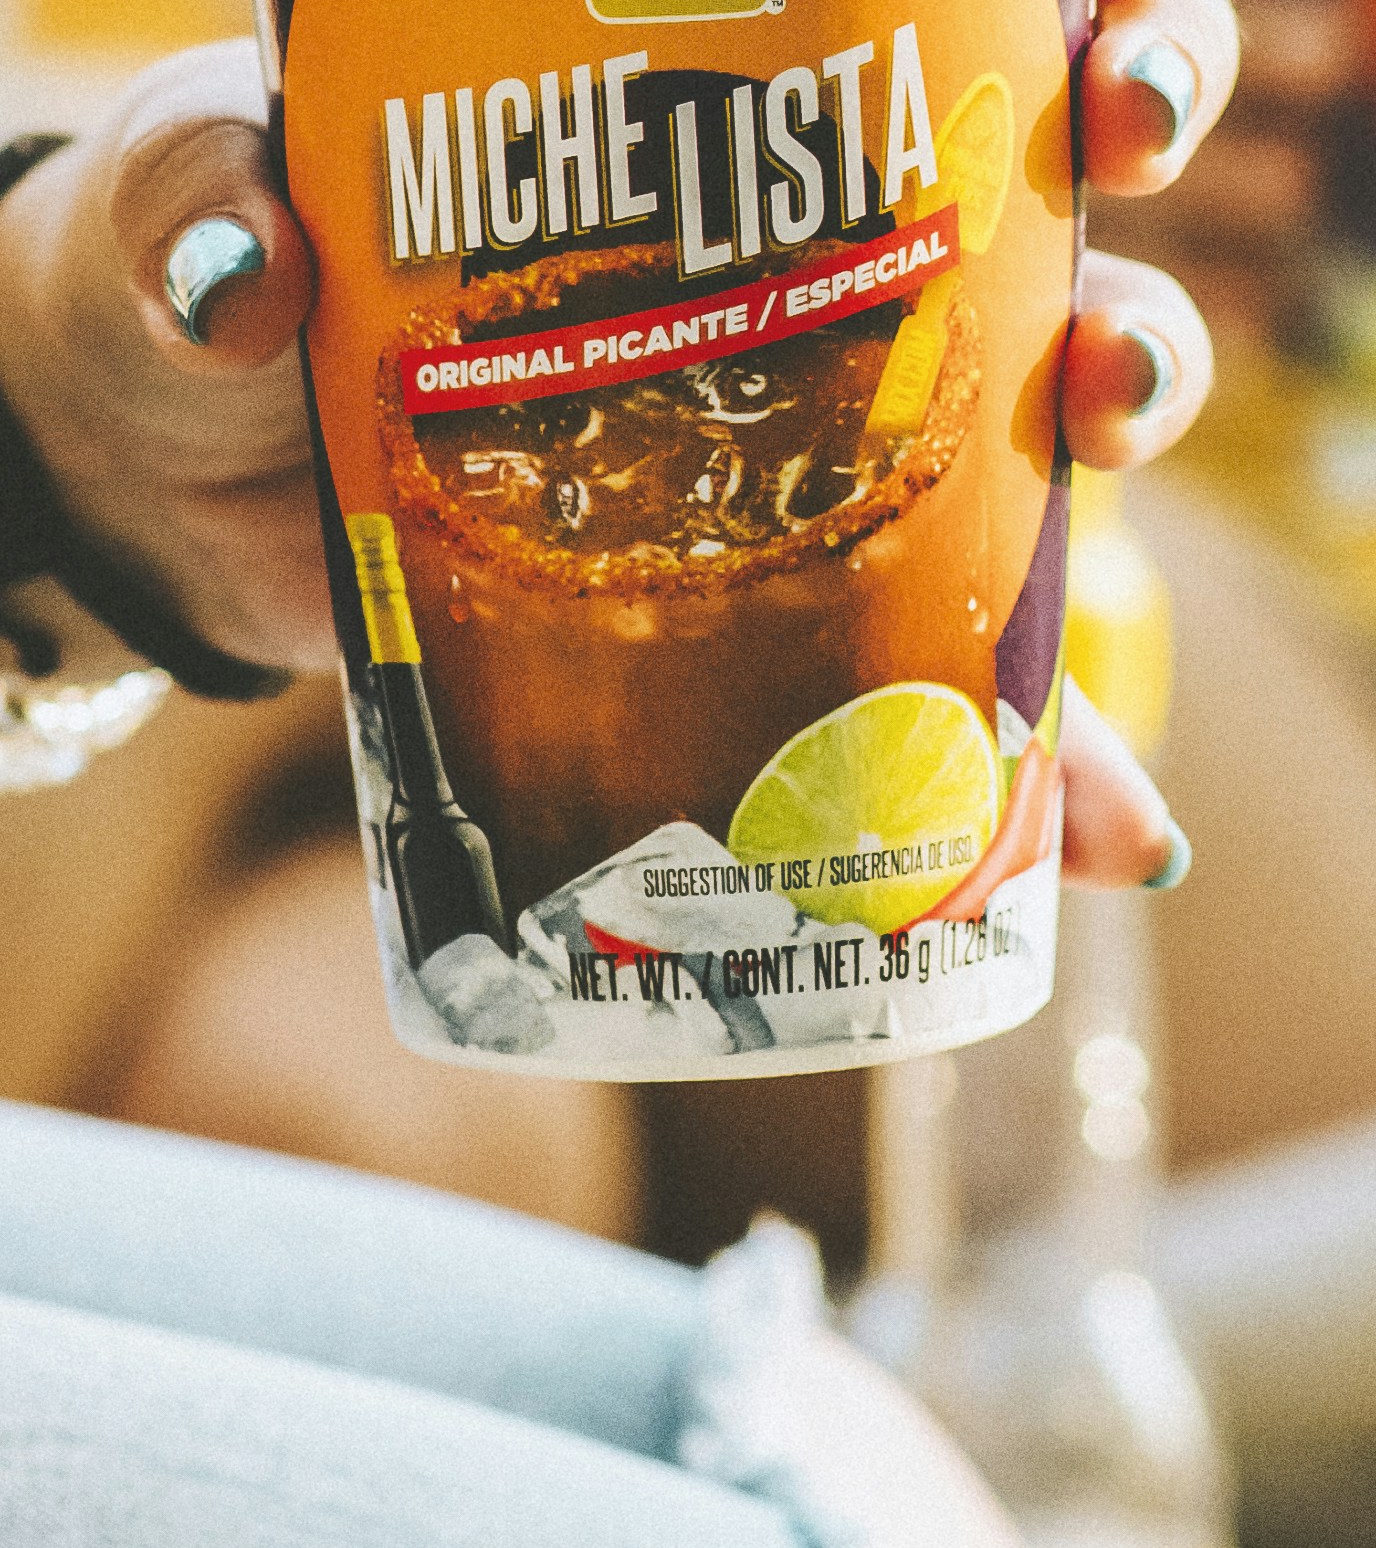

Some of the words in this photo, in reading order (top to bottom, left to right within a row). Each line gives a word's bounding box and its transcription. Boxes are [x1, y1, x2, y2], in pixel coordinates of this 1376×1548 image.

[415, 344, 575, 393] ORIGINAL
[583, 303, 750, 369] PICANTE
[755, 291, 778, 332] /
[785, 231, 949, 318] ESPECIAL
[643, 863, 750, 898] SUGGESTION
[755, 861, 775, 892] OF
[780, 859, 812, 890] USE
[829, 847, 924, 886] SUGERENCIA
[928, 842, 944, 870] DE
[569, 952, 629, 1002] NET.
[634, 951, 692, 1002] WT.
[723, 944, 805, 998] CONT.
[813, 937, 870, 990] NET.
[879, 930, 910, 983] 36
[918, 940, 930, 983] g
